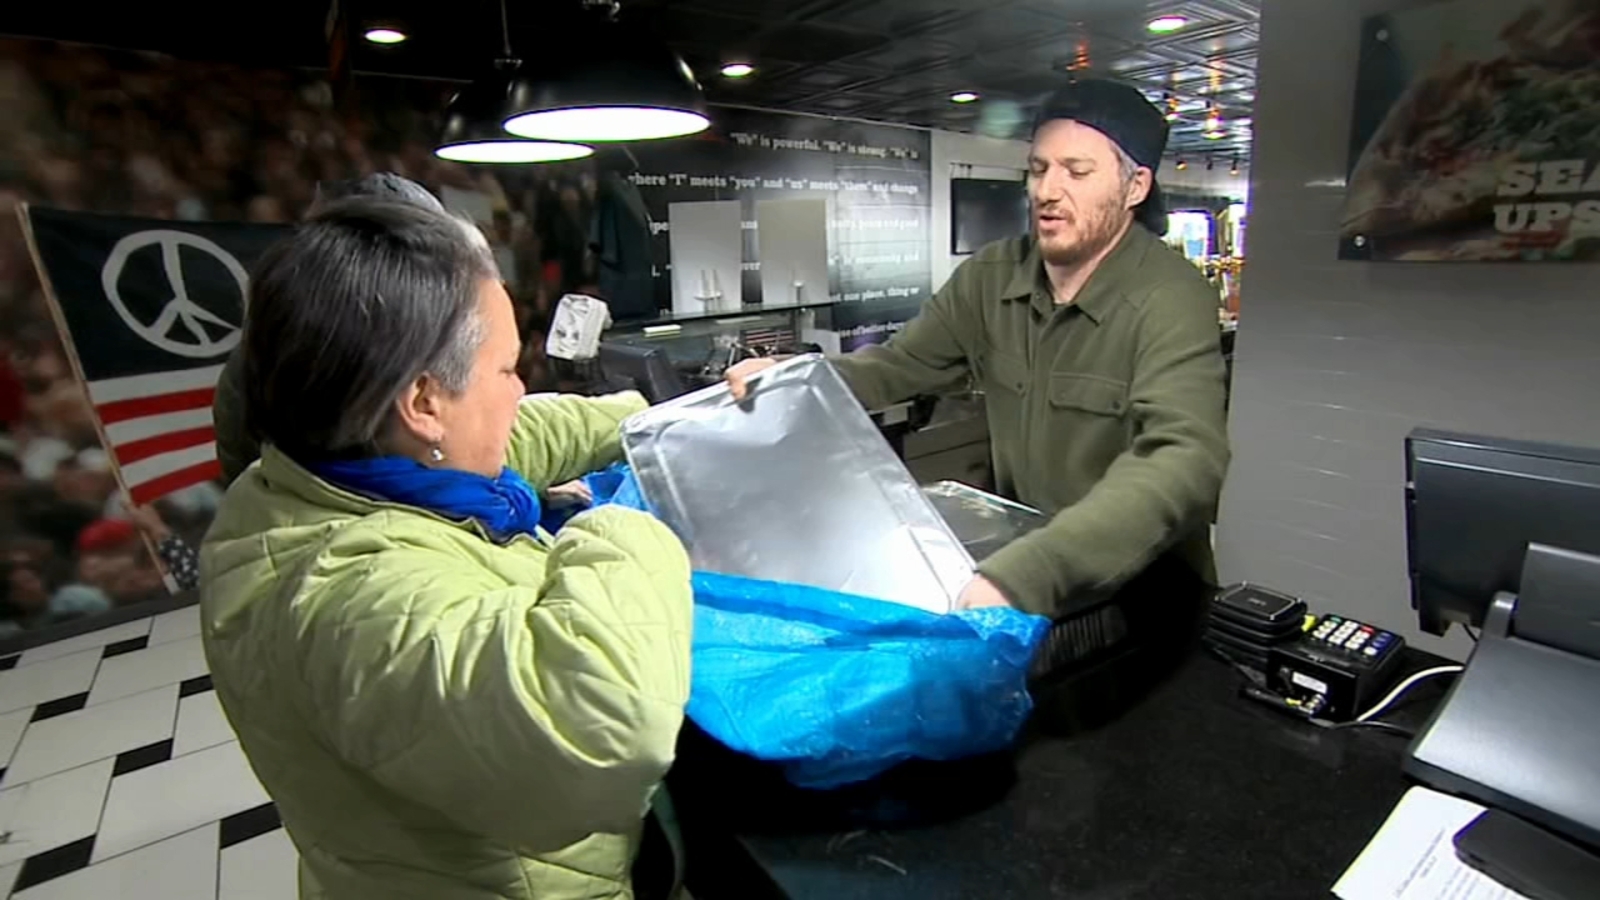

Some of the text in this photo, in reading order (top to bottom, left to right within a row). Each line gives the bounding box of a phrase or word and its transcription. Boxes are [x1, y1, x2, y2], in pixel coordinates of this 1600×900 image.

[760, 134, 770, 147] is
[772, 137, 821, 150] powerful.
[690, 175, 727, 188] meets
[729, 176, 760, 190] "you"
[763, 177, 783, 188] and
[785, 179, 808, 190] "us"
[809, 179, 839, 190] meets
